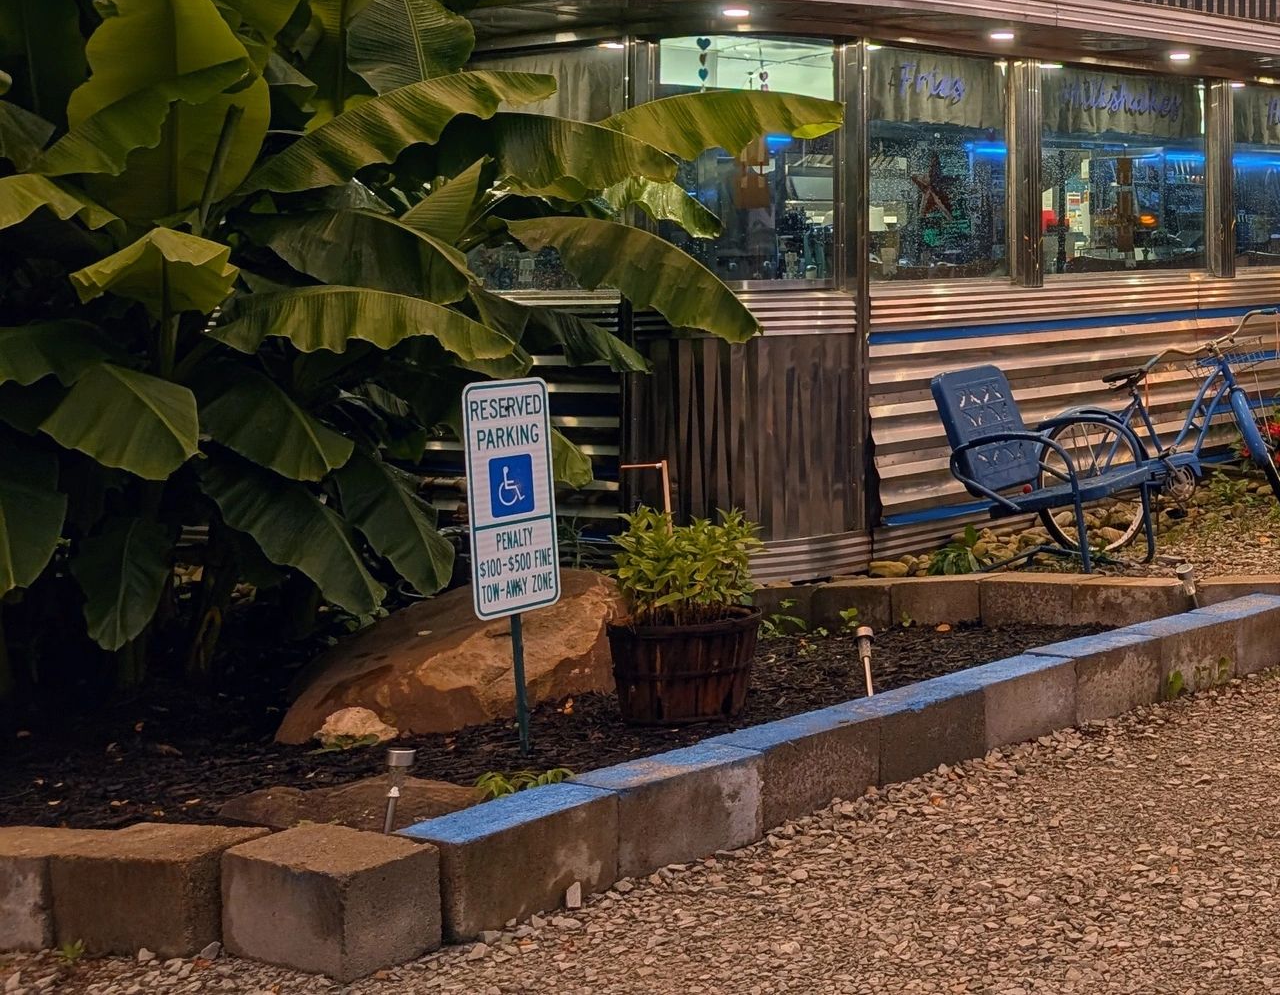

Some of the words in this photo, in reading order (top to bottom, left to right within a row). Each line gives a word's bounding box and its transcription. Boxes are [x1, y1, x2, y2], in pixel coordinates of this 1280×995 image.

[898, 61, 966, 108] Fries
[469, 394, 542, 422] RESERVED
[476, 423, 540, 451] PARKING
[495, 526, 533, 552] PENALTY
[479, 551, 532, 579] $100-$500
[534, 547, 553, 568] FINE
[481, 576, 528, 604] TOW-AWAY
[531, 571, 554, 593] ZONE
